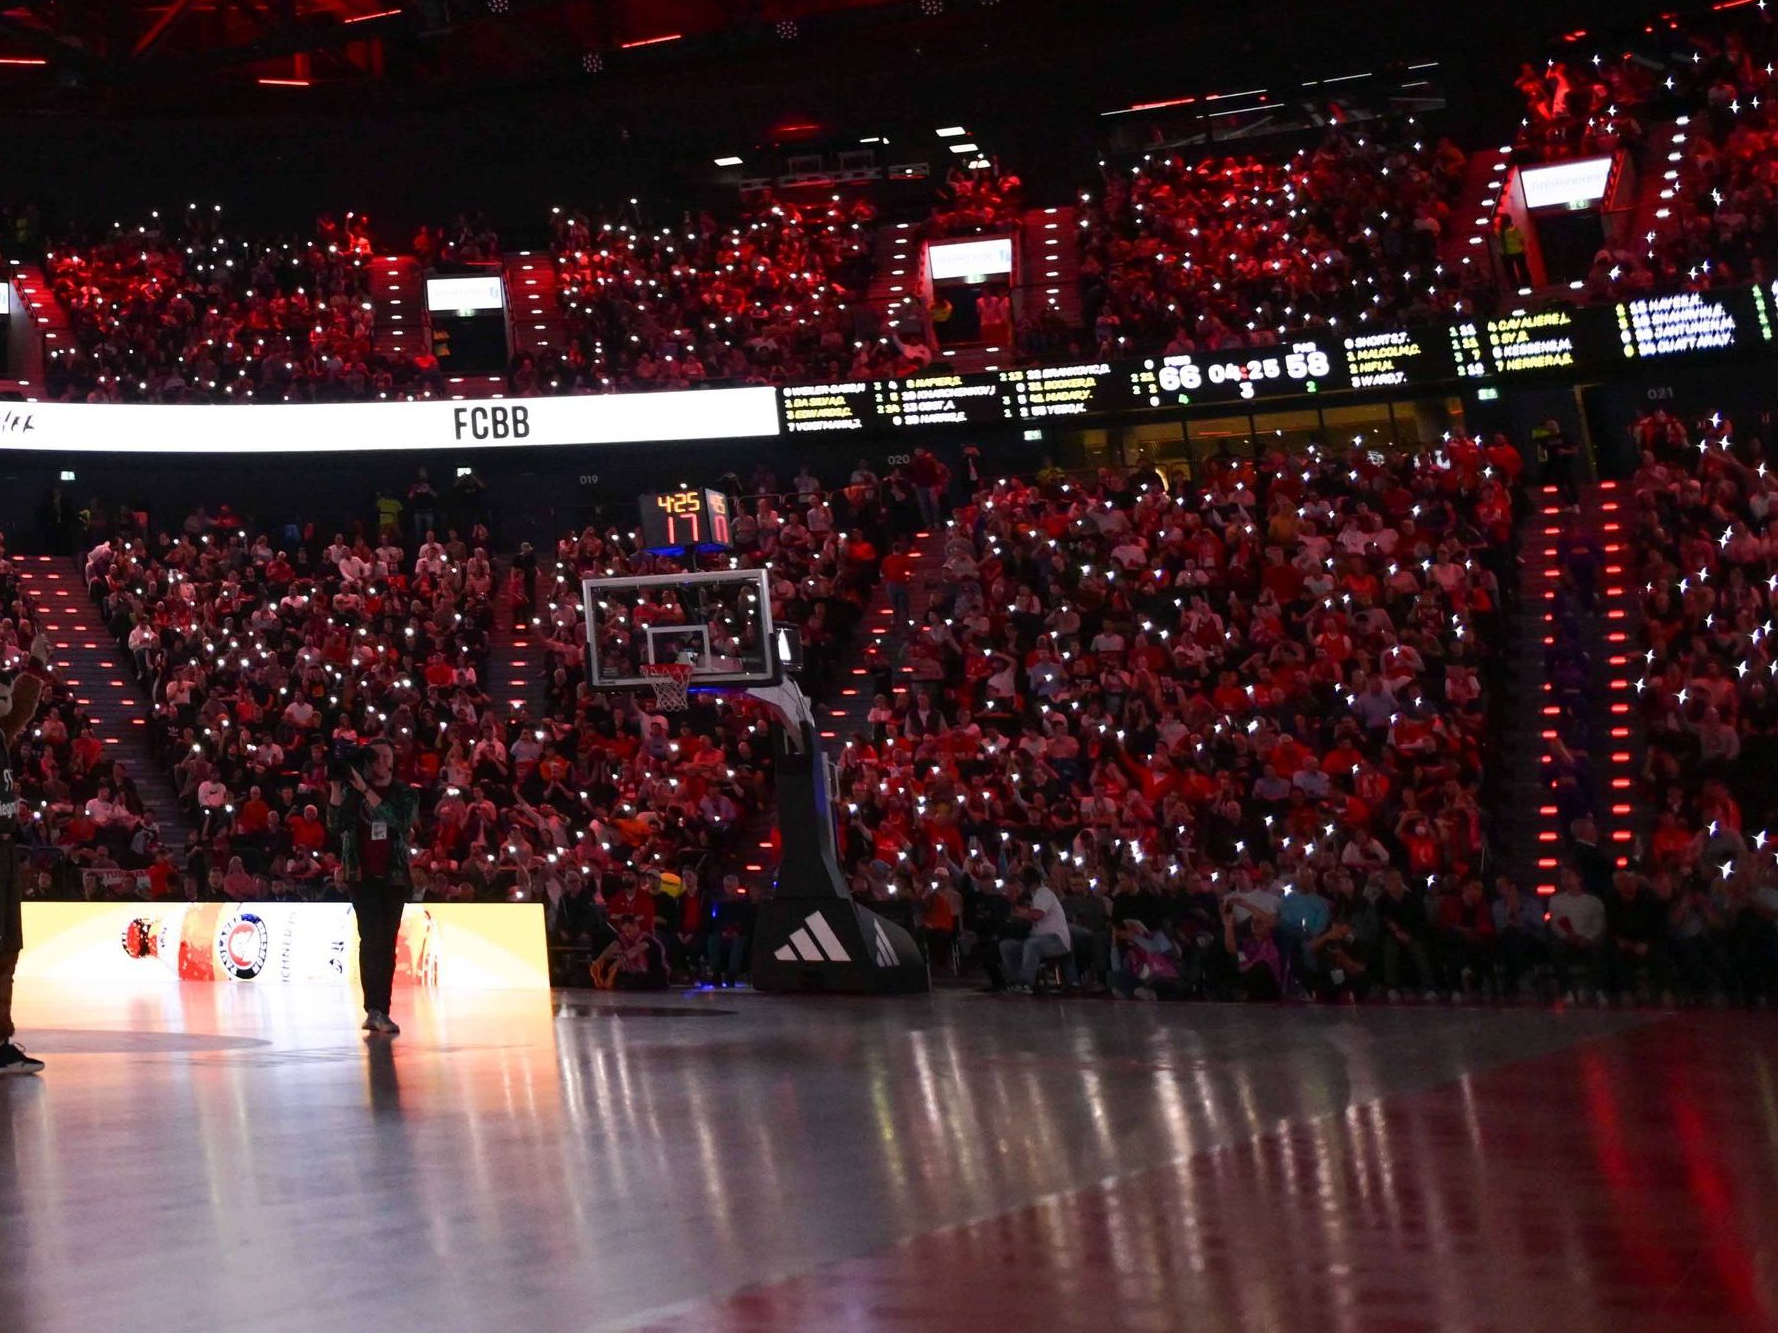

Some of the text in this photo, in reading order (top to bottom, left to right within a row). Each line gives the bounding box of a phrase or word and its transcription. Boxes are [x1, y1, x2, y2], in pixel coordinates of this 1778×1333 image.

[1159, 365, 1202, 391] 66
[1208, 358, 1280, 384] 04:25
[1285, 351, 1330, 379] 58
[1239, 381, 1255, 399] 3
[1647, 386, 1673, 400] 021
[454, 406, 530, 440] FCBB
[887, 454, 910, 465] 020
[579, 473, 598, 485] 019
[658, 492, 700, 513] 4:25
[667, 513, 699, 544] 17
